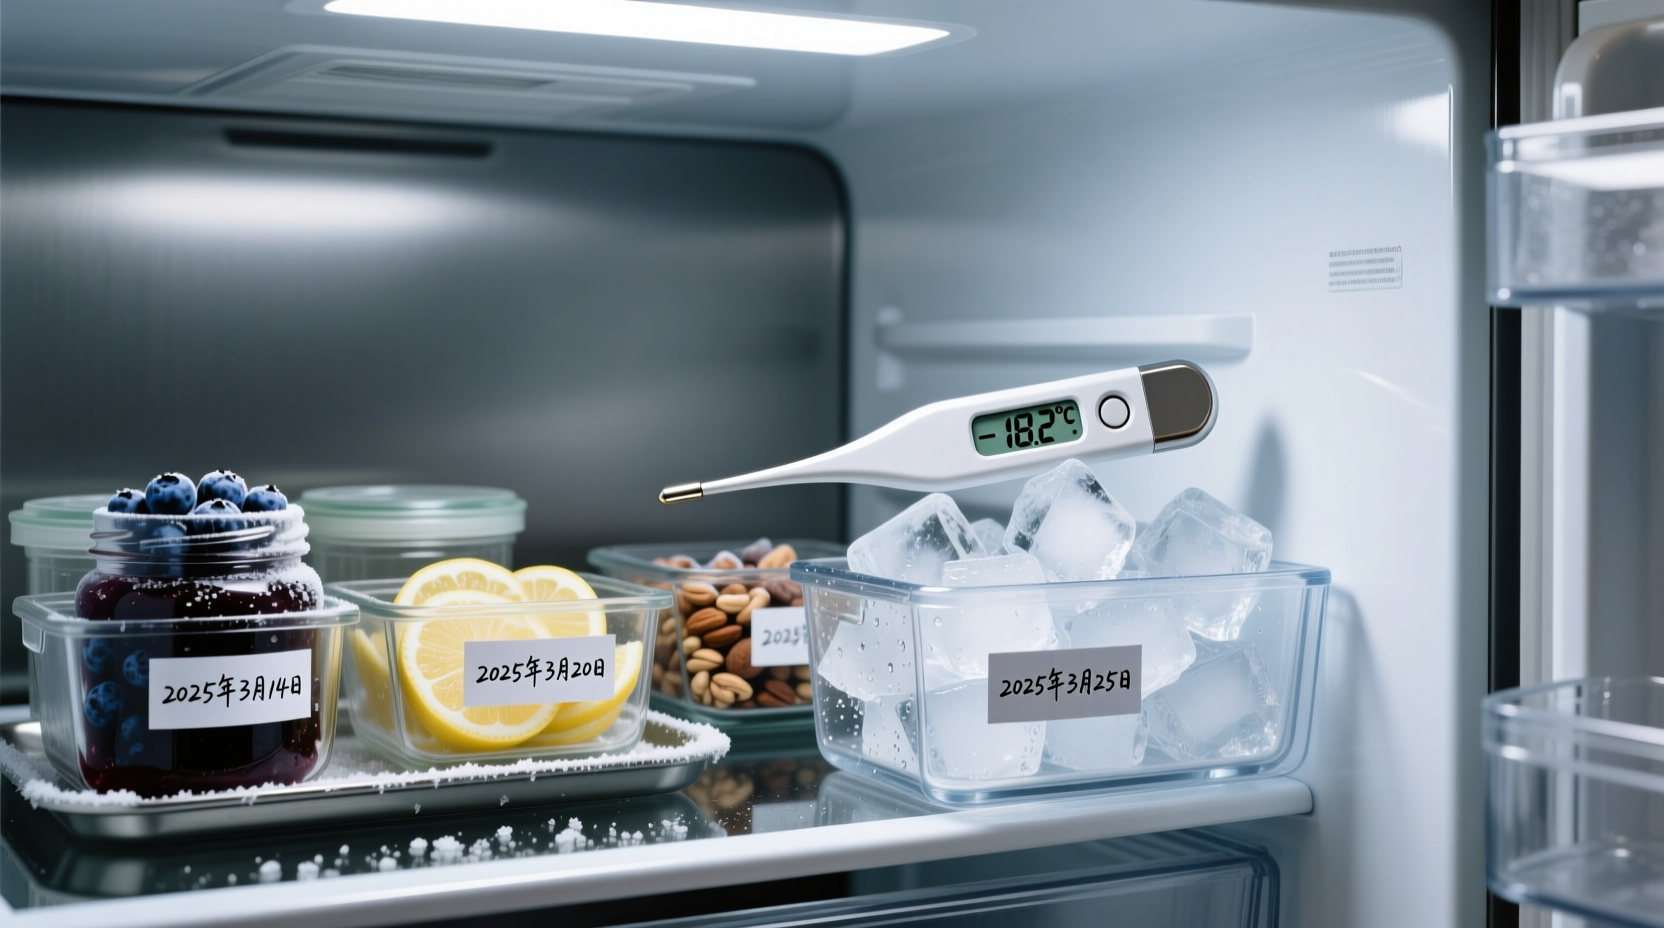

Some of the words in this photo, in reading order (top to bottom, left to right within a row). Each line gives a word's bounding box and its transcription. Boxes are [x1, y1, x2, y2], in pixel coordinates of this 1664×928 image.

[476, 655, 605, 688] 2025年3月20日
[999, 667, 1131, 702] 2025年3月25日
[162, 673, 302, 708] 2025年3月14日
